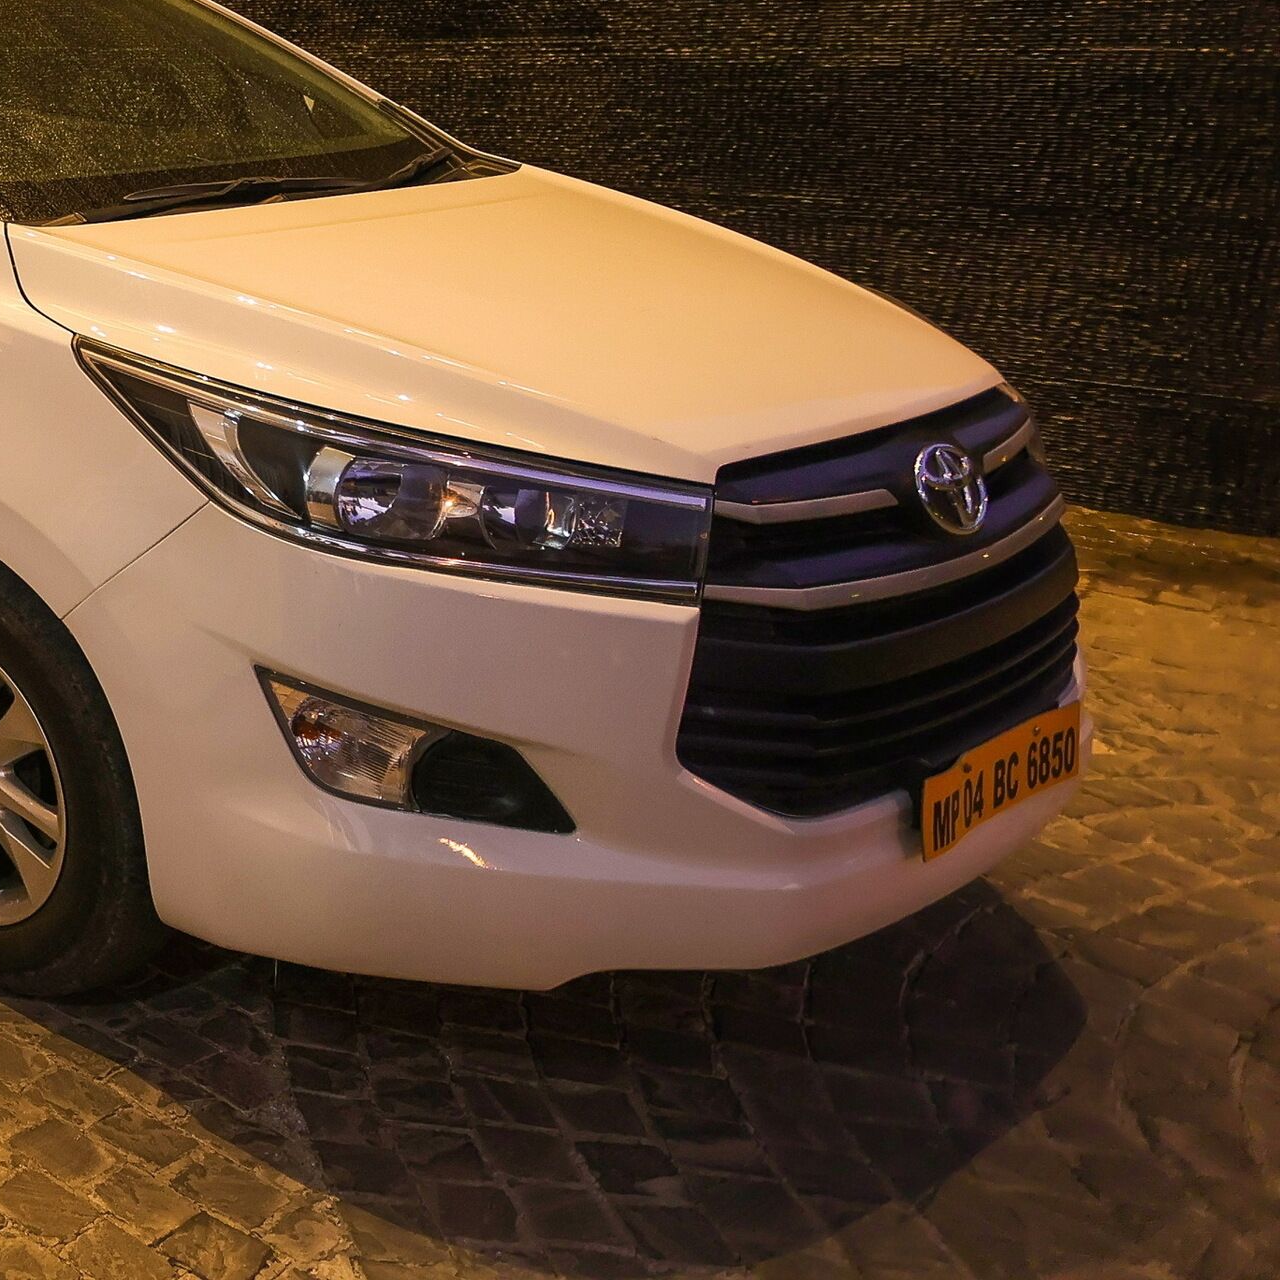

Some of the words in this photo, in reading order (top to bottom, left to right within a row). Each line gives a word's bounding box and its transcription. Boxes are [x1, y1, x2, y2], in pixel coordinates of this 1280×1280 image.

[933, 789, 960, 852] MP
[963, 769, 984, 829] 04
[993, 751, 1019, 809] BC
[1027, 726, 1075, 790] 6850
